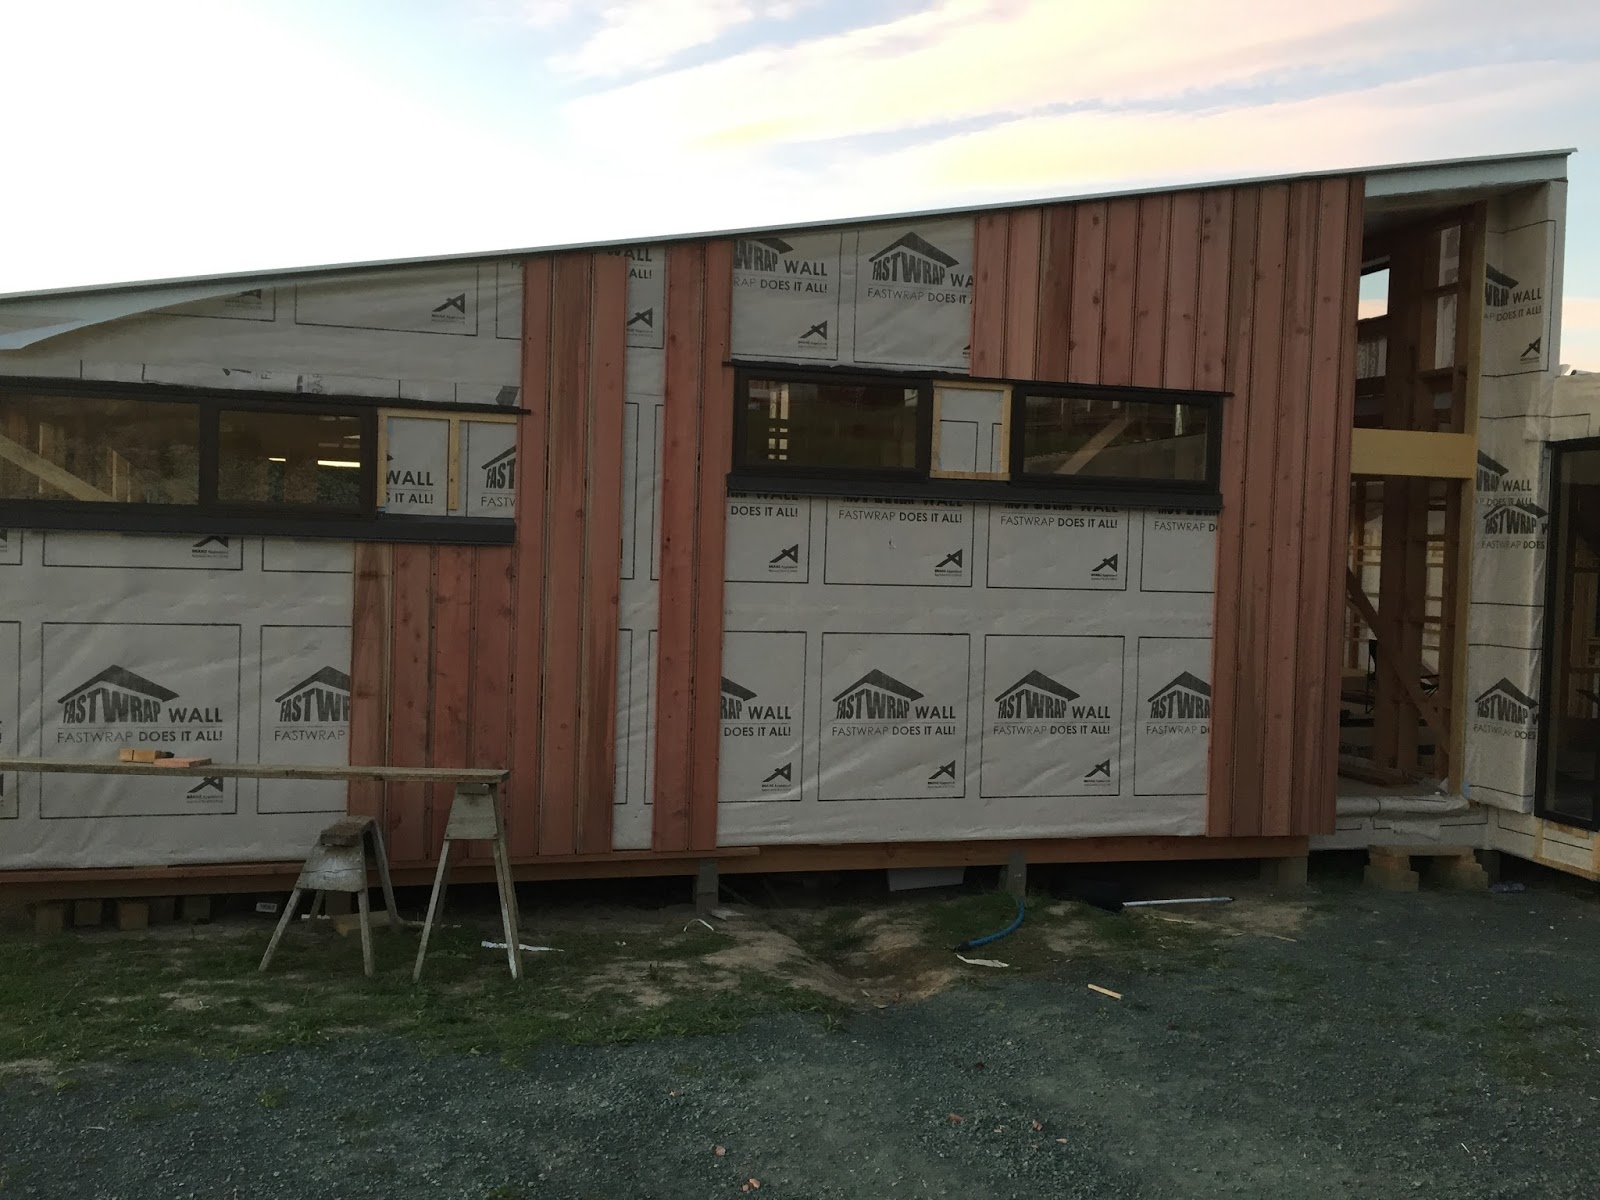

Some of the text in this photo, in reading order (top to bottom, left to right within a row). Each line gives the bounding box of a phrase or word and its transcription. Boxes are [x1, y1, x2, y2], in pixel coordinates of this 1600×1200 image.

[628, 267, 653, 280] ALL!
[784, 259, 828, 276] WALL
[872, 250, 946, 286] FASTWRAP
[760, 279, 790, 291] DOES
[793, 281, 802, 292] IT
[805, 282, 828, 294] ALL!
[867, 287, 925, 301] FASTWRAP
[927, 292, 956, 304] DOES
[958, 294, 967, 305] IT
[1512, 287, 1543, 305] WALL
[1496, 310, 1517, 322] DOES
[1502, 480, 1532, 492] WALL
[394, 492, 404, 503] IT
[408, 492, 434, 504] ALL!
[730, 505, 799, 518] DOES IT ALL!
[838, 509, 963, 524] FASTWRAP DOES IT ALL!
[1000, 515, 1118, 529] FASTWRAP DOES IT ALL!
[1154, 520, 1206, 532] FASTWRAP
[1523, 540, 1546, 550] DOES
[62, 687, 223, 725] FASTWRAP WALL
[836, 688, 956, 720] FASTWRAP WALL
[997, 688, 1111, 720] FASTWRAP WALL
[748, 705, 792, 720] WALL
[56, 730, 223, 744] FASTWRAP DOES IT ALL!
[274, 729, 346, 741] FASTWRAP
[723, 726, 792, 737] DOES IT ALL!
[831, 725, 956, 737] FASTWRAP DOES IT ALL!
[993, 725, 1111, 736] FASTWRAP DOES IT ALL!
[1146, 725, 1198, 736] FASTWRAP
[1514, 730, 1537, 740] DOES
